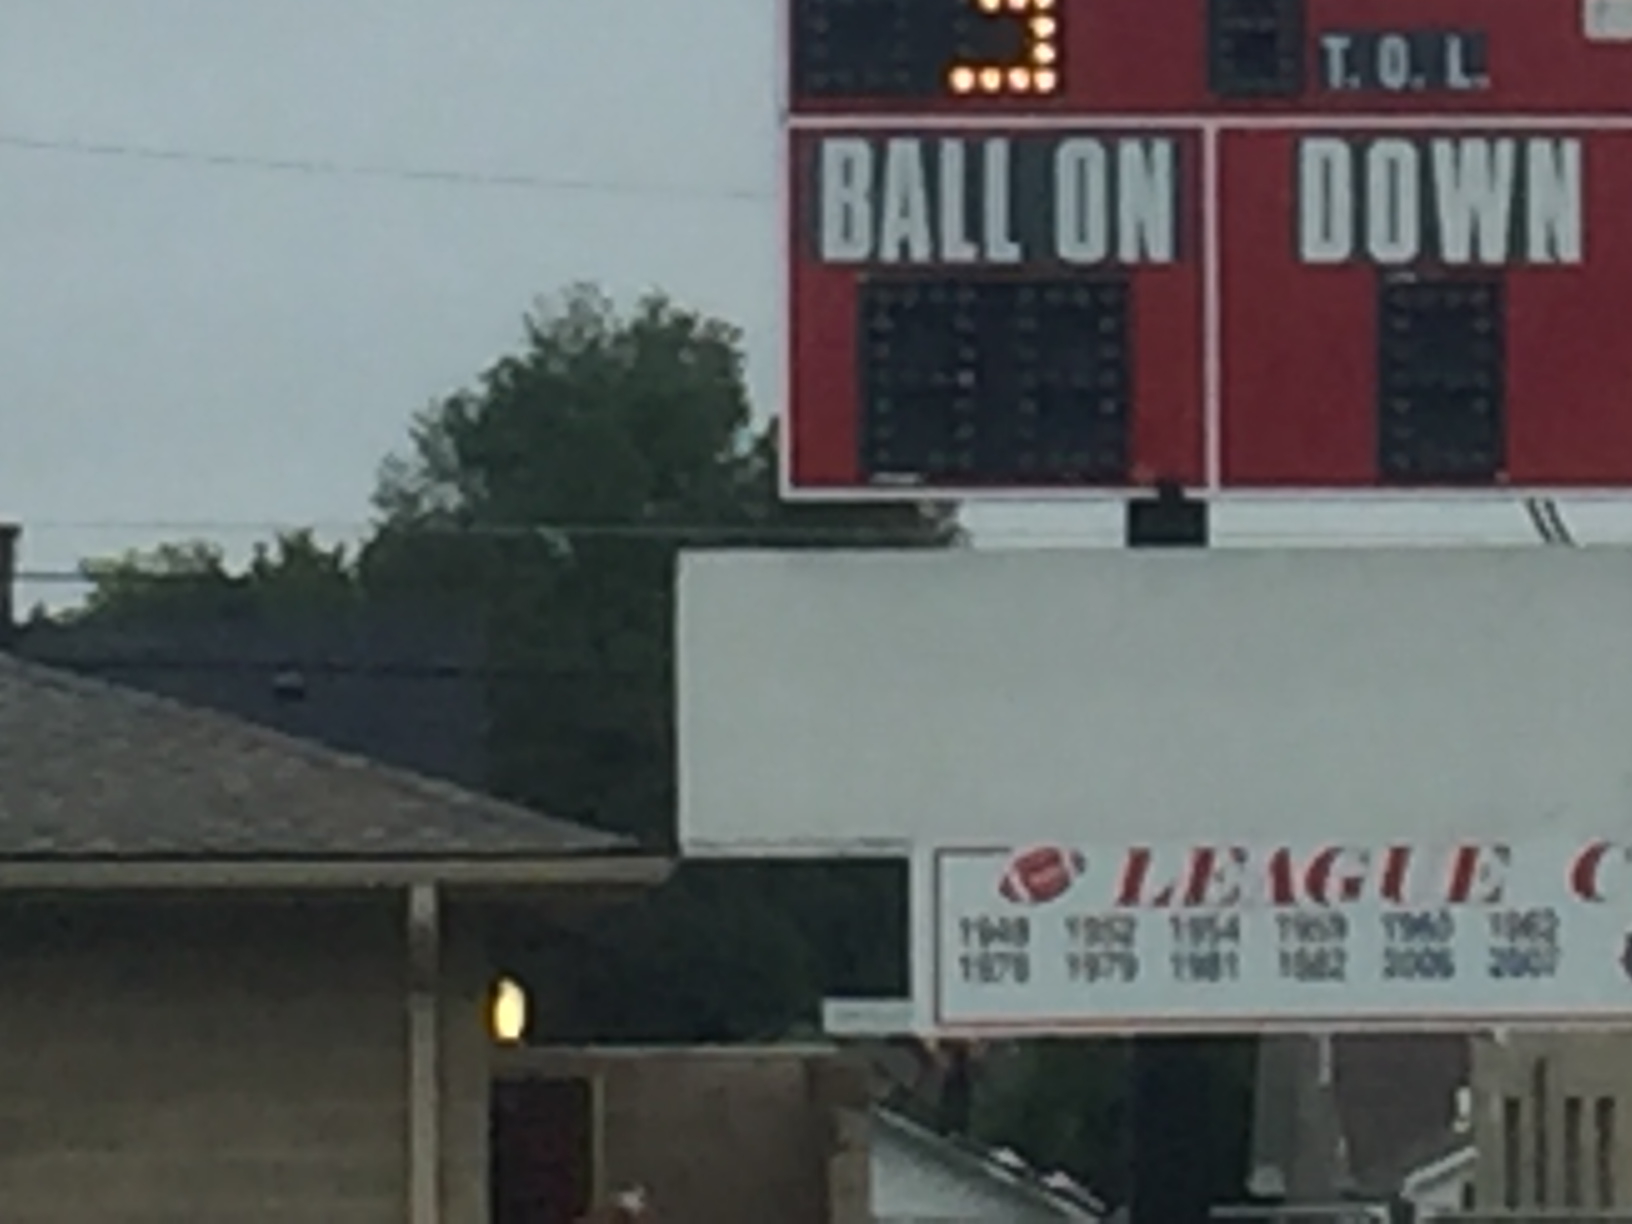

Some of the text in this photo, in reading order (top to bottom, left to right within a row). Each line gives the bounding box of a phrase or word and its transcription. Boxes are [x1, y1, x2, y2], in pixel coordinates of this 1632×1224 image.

[819, 137, 1175, 264] BALL ON
[1298, 137, 1583, 264] DOWN
[1115, 845, 1512, 909] LEAGUE
